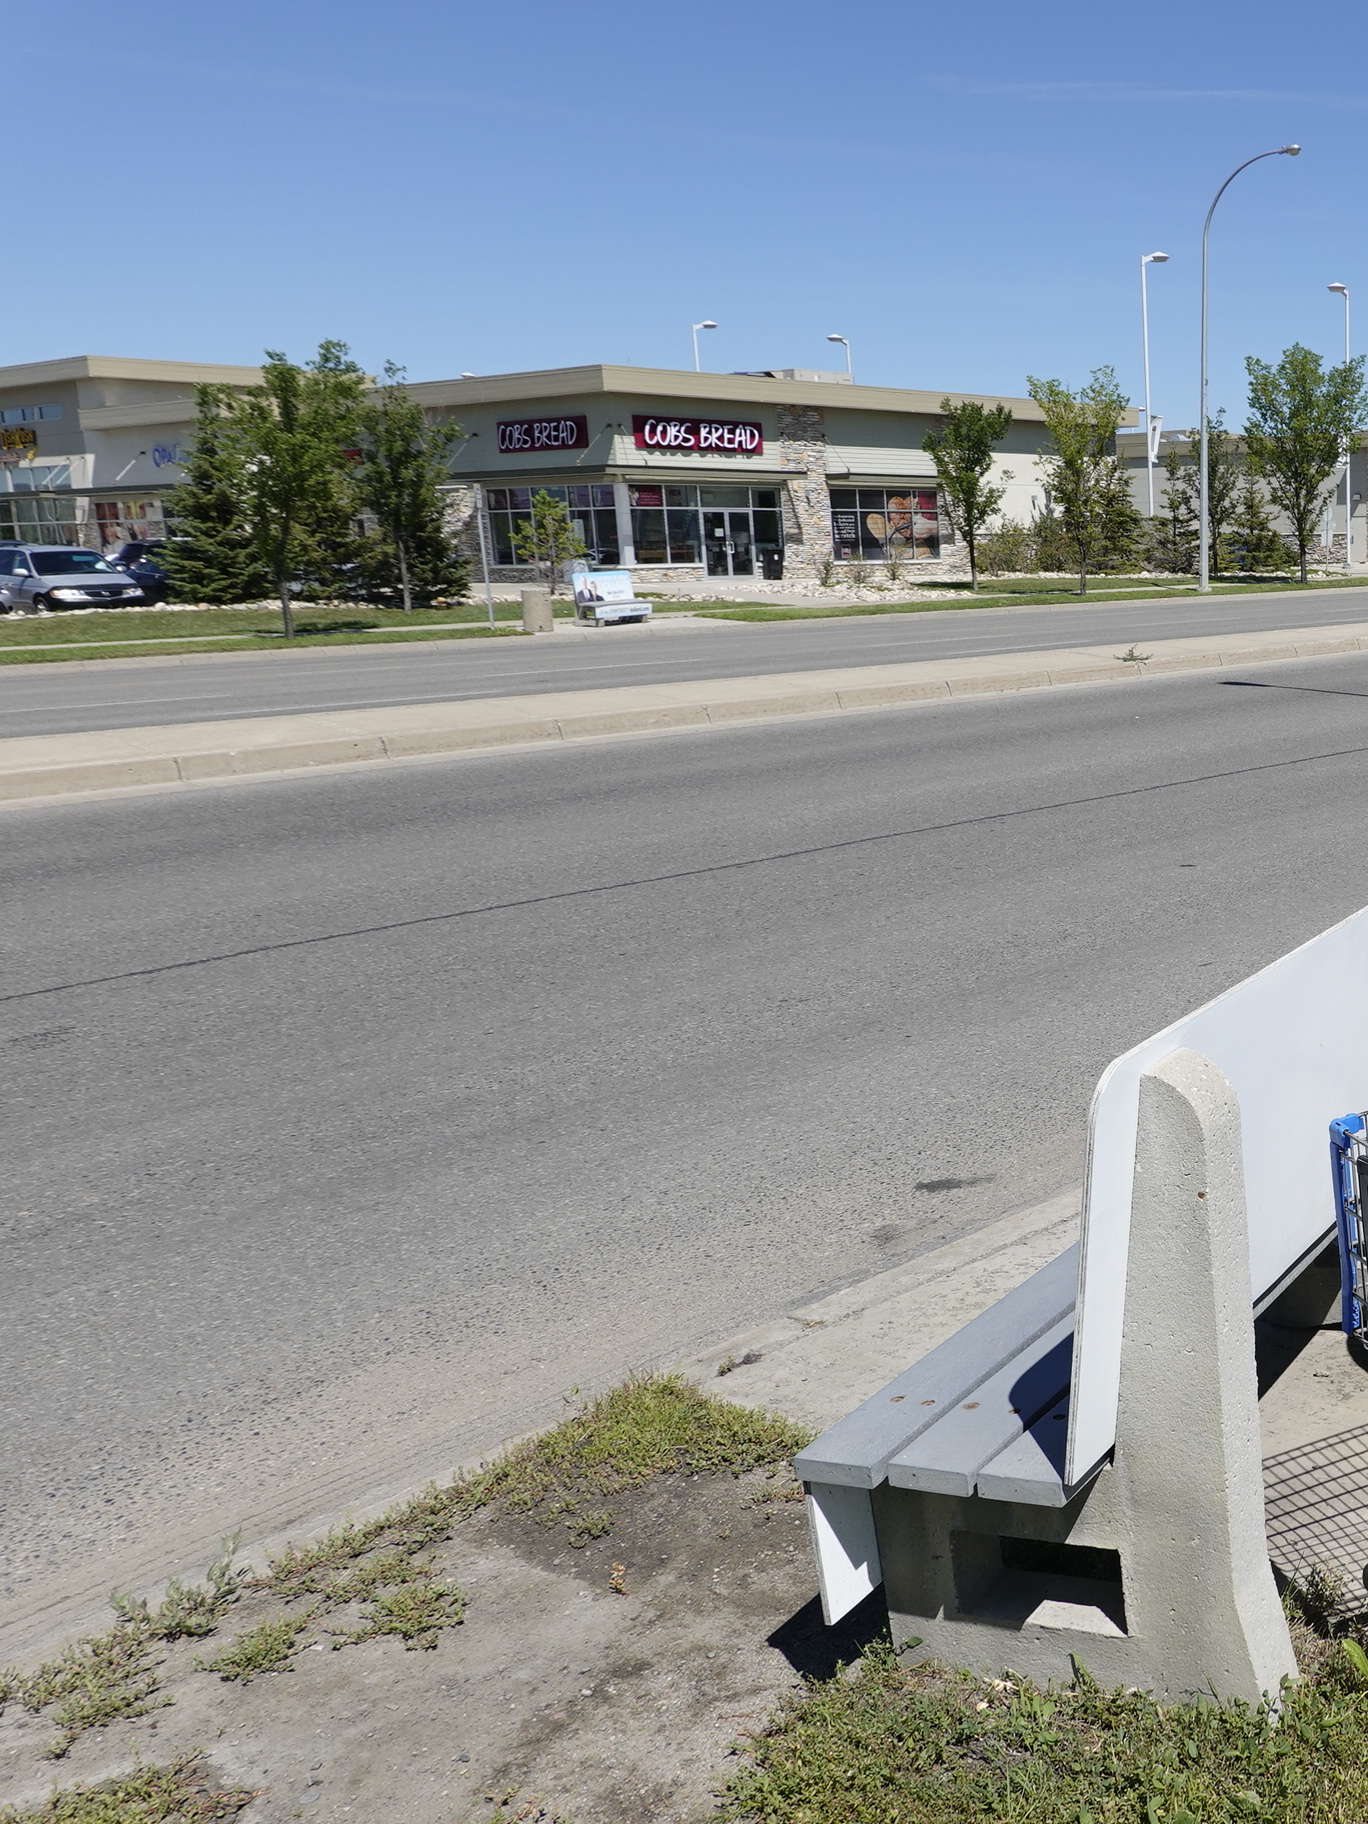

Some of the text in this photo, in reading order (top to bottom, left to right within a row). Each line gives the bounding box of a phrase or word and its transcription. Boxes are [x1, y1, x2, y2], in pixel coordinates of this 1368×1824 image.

[499, 420, 577, 449] COBS BREAD
[644, 419, 758, 450] COBS BREAD
